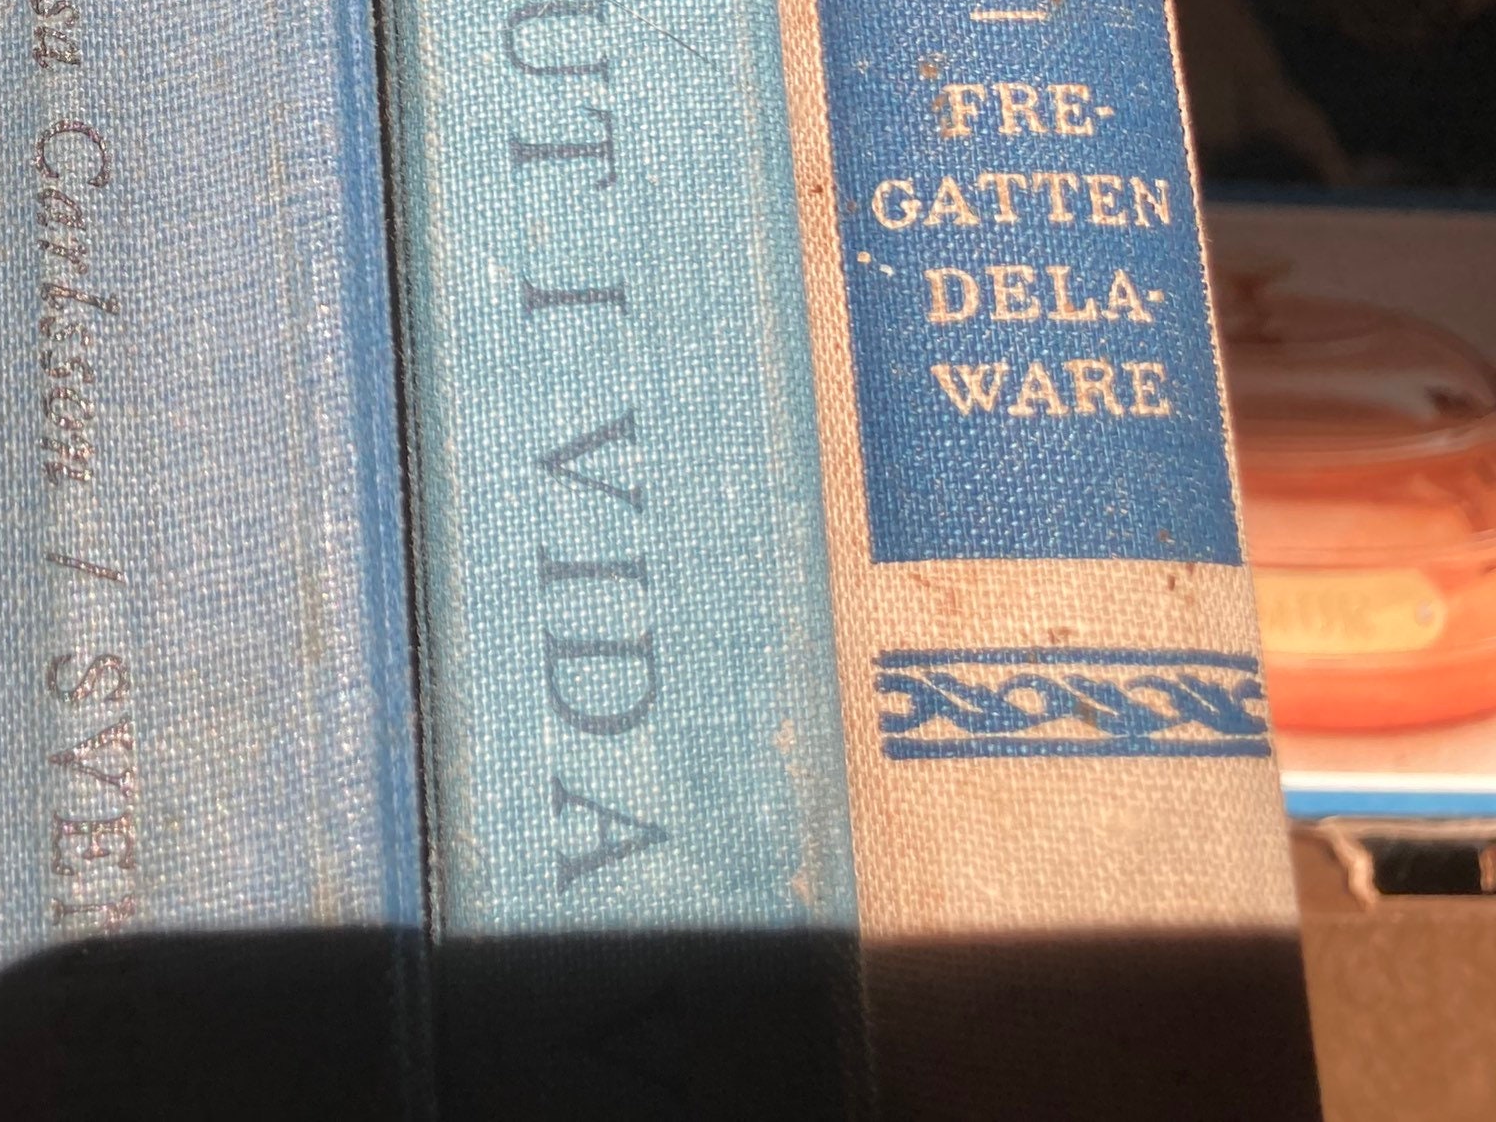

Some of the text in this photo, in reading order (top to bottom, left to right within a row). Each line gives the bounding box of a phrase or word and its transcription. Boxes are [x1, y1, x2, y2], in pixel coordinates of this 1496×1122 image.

[938, 81, 1114, 139] FRE-
[869, 171, 1175, 231] GATTEN
[34, 117, 119, 481] Carlsson
[522, 276, 630, 316] I
[921, 264, 1165, 324] DELA-
[930, 359, 1174, 419] WARE
[538, 407, 670, 890] VIDA
